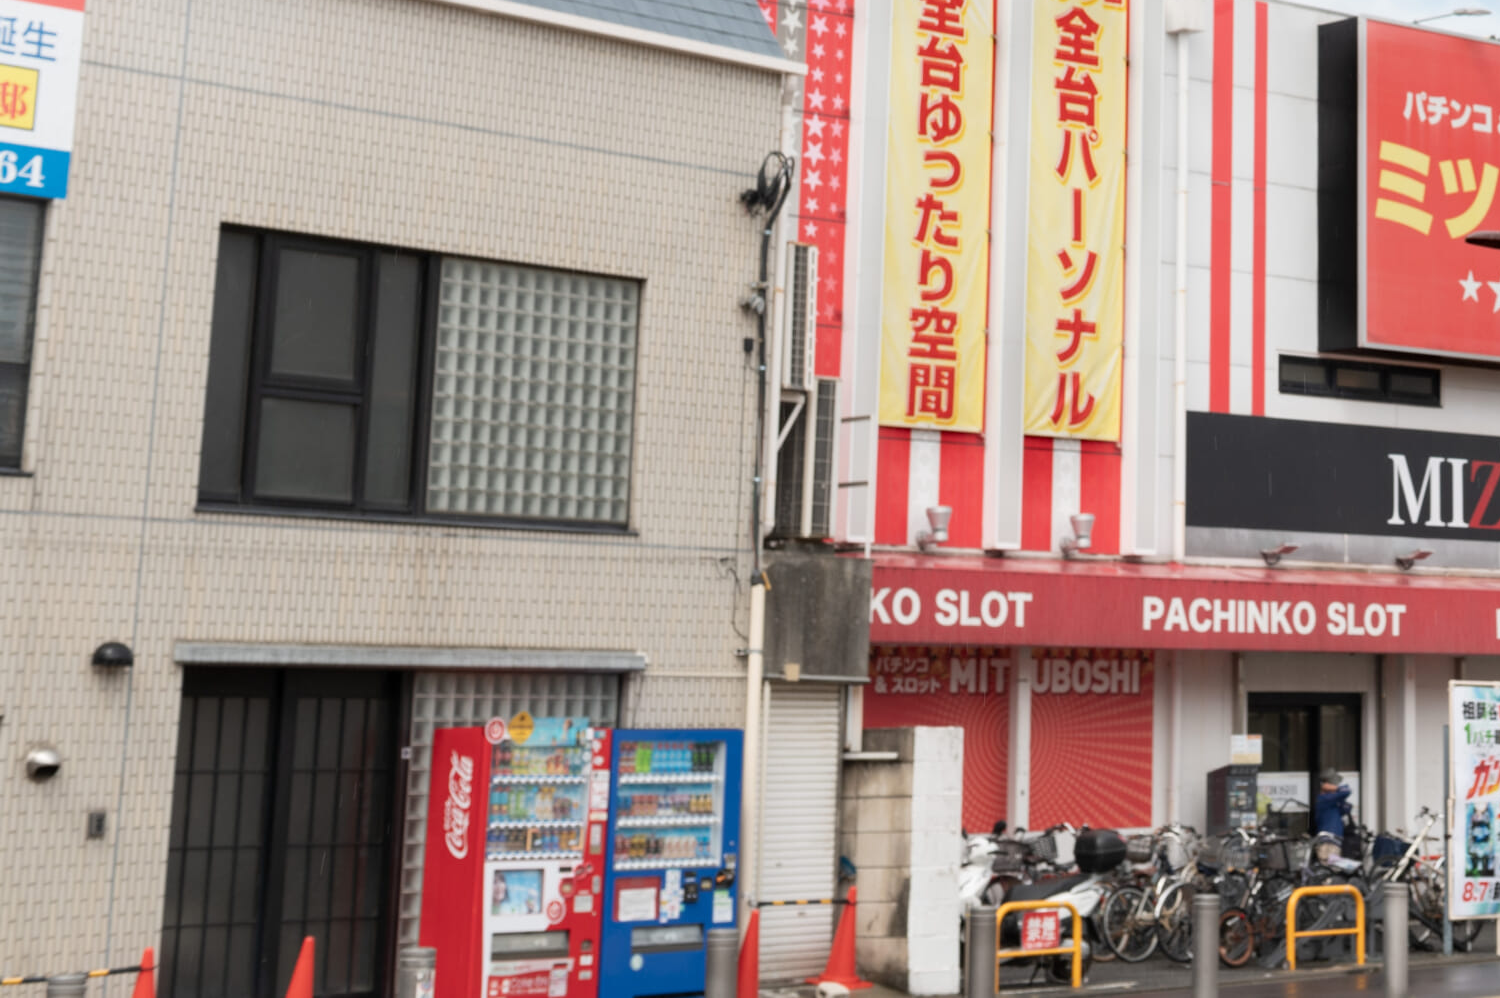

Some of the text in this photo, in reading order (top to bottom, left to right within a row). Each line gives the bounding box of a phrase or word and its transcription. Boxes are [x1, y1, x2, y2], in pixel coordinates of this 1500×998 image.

[1049, 6, 1100, 428] 全台パーソナル
[934, 588, 1034, 628] SLOT
[1142, 596, 1407, 637] PACHINKO SLOT
[875, 656, 930, 674] パチンコ
[951, 657, 1141, 695] MITUBOSHI
[1462, 880, 1489, 902] 8.7
